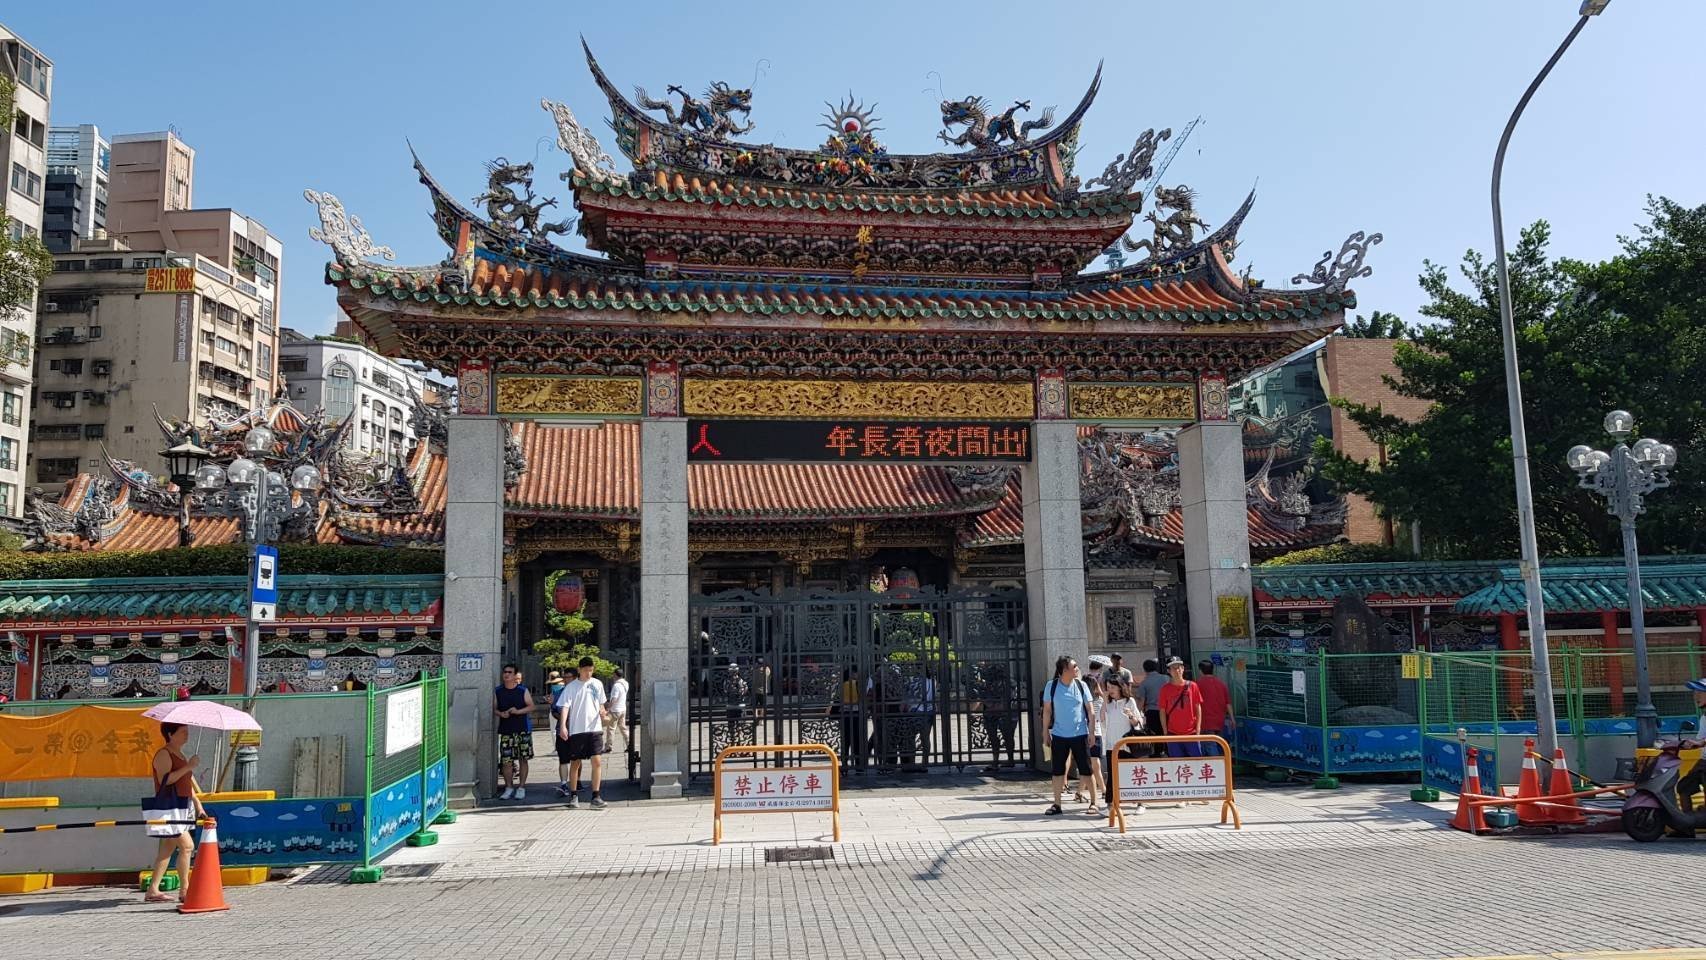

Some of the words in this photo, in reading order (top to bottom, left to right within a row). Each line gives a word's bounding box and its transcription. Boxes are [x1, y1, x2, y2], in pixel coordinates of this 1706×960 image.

[825, 425, 1027, 457] 年長者夜間出
[460, 659, 479, 669] 211
[734, 773, 822, 796] 禁止停車
[1131, 763, 1217, 786] 禁止停車
